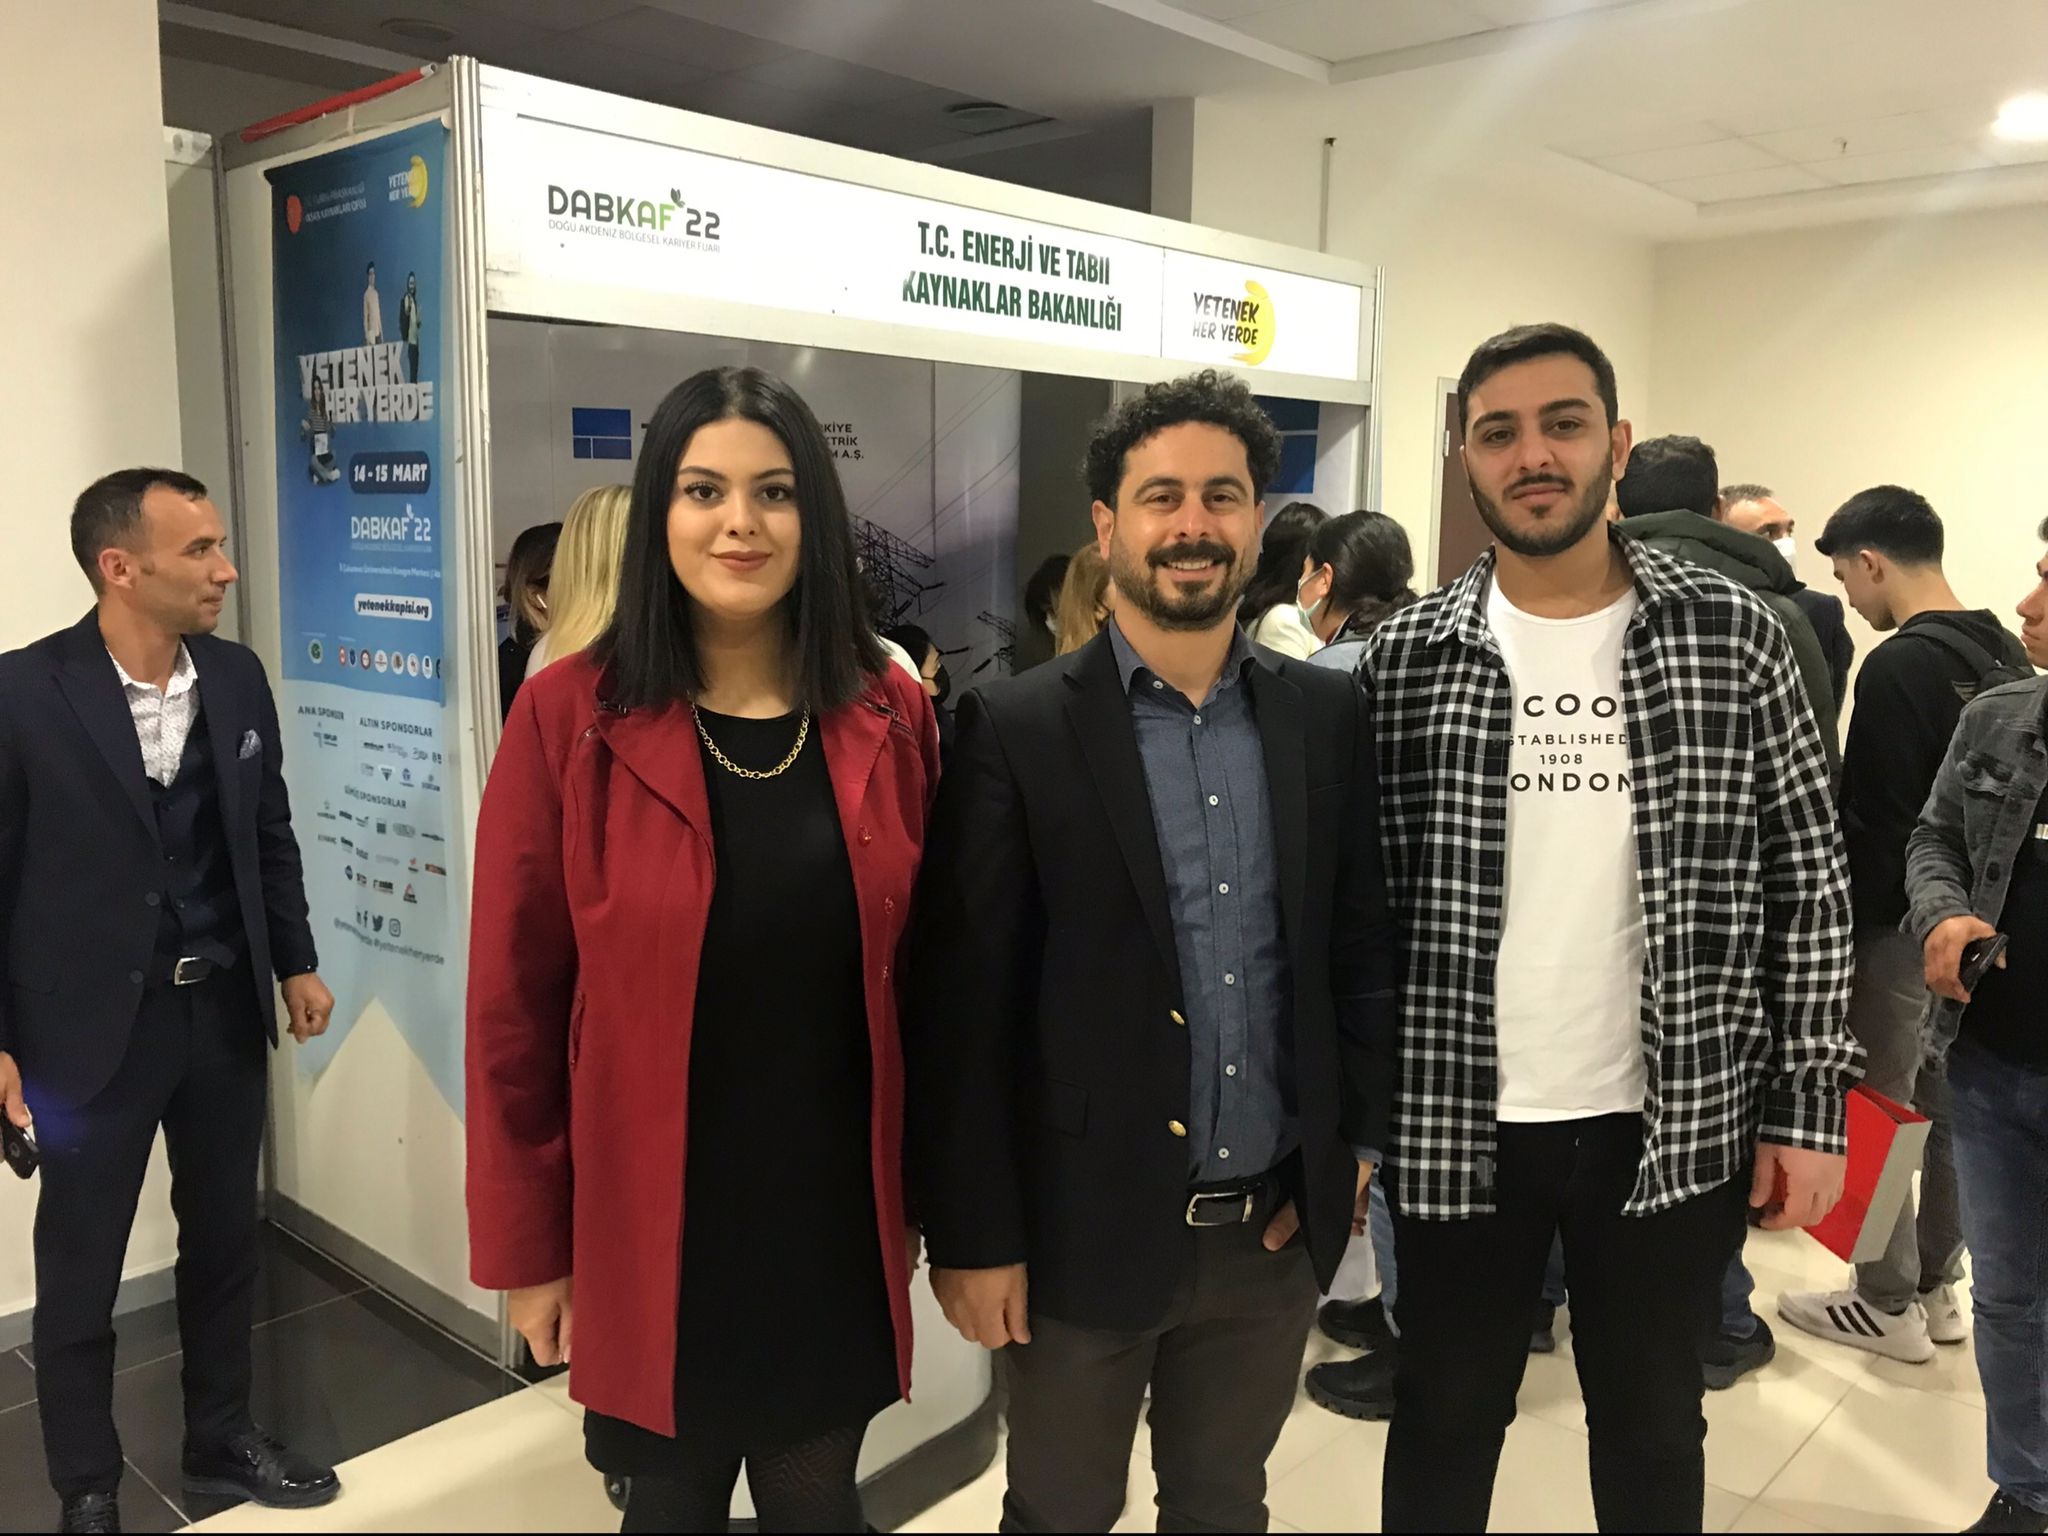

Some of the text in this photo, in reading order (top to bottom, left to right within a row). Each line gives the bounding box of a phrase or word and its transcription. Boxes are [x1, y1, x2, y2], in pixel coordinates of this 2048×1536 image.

[548, 184, 675, 231] DABKAF
[548, 219, 577, 233] DOĞU
[917, 220, 955, 259] T.C.
[962, 229, 1033, 272] ENERJİ
[1039, 243, 1061, 277] VE
[902, 270, 1122, 332] KAYNAKLAR BAKANLIĞI
[1193, 291, 1259, 324] YETENEK
[1192, 320, 1258, 345] HER YERDE
[298, 340, 405, 399] YETENEK
[323, 381, 434, 424] HER YERDE
[823, 421, 853, 433] KİYE
[826, 434, 858, 446] TRİK
[392, 463, 428, 482] MART
[351, 516, 410, 541] DABKAF
[358, 599, 430, 618] yetenekkapisi.org
[298, 706, 317, 716] ANA
[1523, 693, 1617, 718] COO
[359, 717, 433, 737] ALTIN SPONSORLAR
[1509, 734, 1627, 746] STABLISHED
[1540, 754, 1583, 765] 1908
[1510, 772, 1631, 792] ONDON
